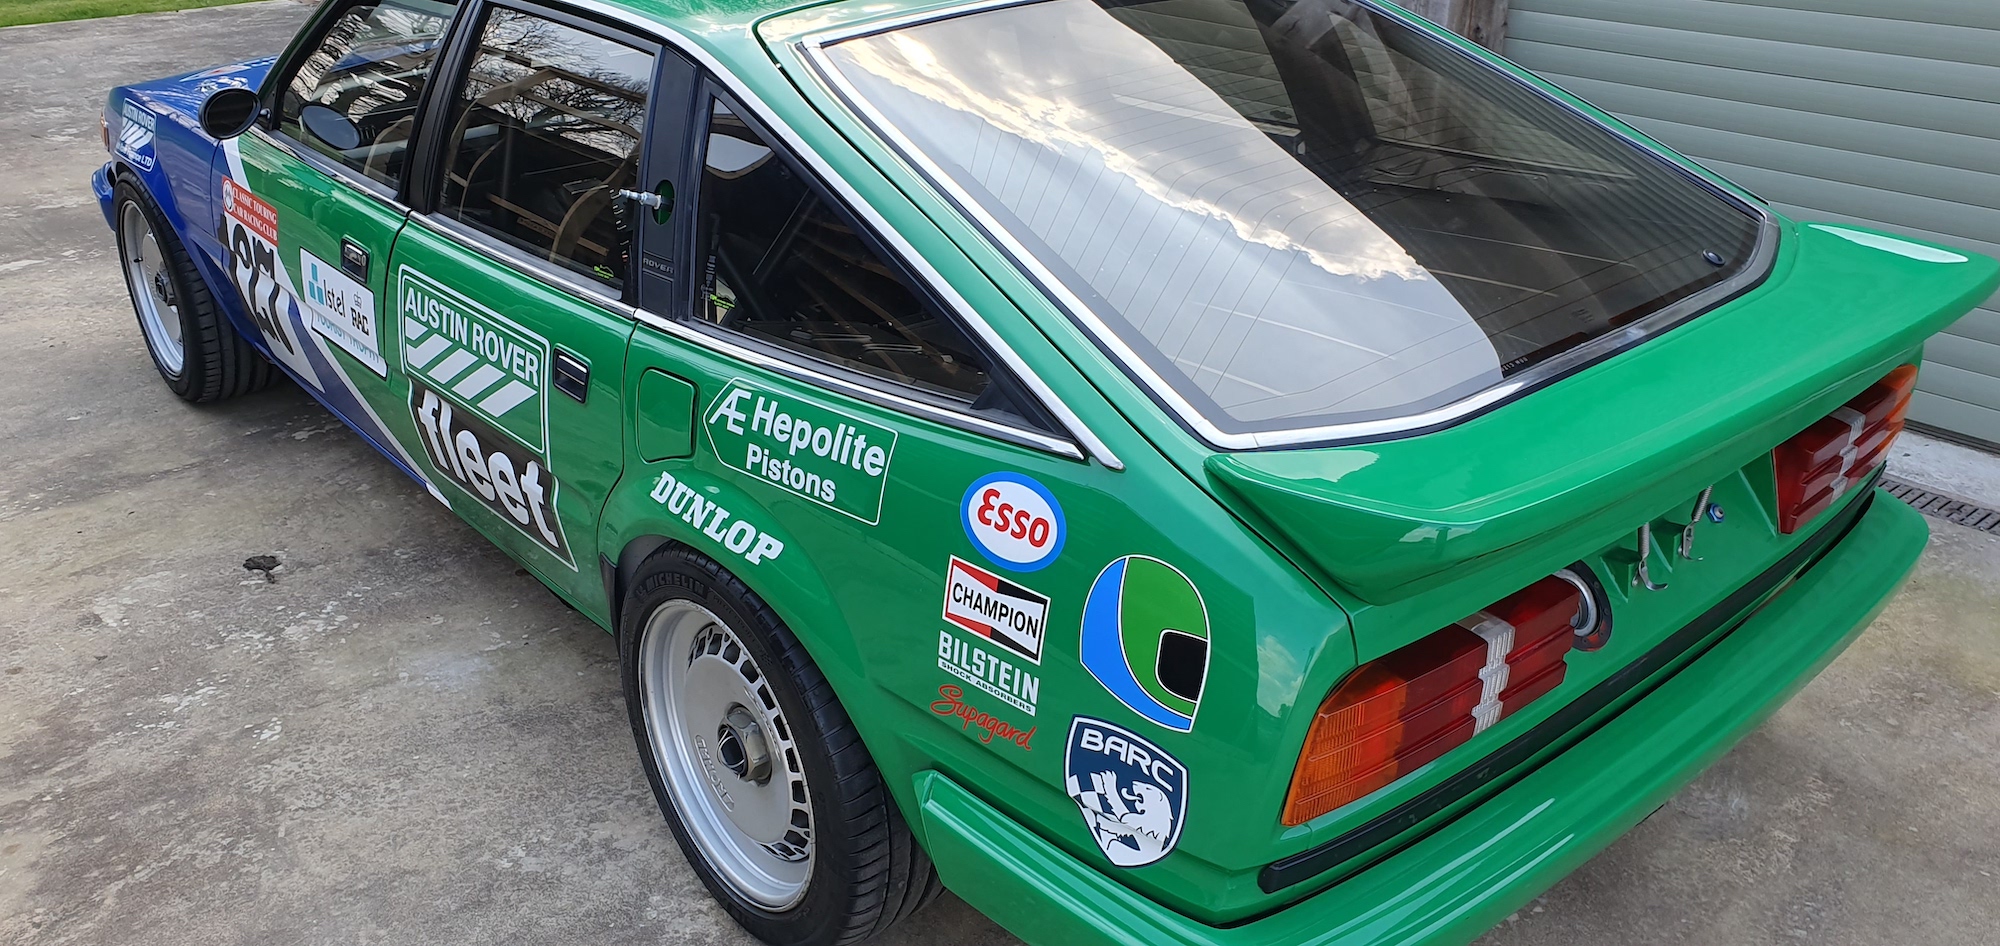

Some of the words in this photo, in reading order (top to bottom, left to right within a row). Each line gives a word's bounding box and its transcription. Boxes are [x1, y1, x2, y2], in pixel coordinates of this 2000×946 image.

[234, 203, 244, 217] CAR
[244, 210, 263, 231] RACING
[263, 223, 278, 241] CLUB
[253, 200, 277, 224] TOURING
[643, 258, 673, 273] ROVER
[350, 307, 369, 336] RAC
[405, 287, 468, 346] AUSTIN
[472, 323, 539, 387] ROVER
[751, 396, 886, 477] Hepolite
[418, 389, 559, 548] fleet
[746, 442, 837, 503] Pistons
[650, 471, 784, 566] DUNLOP
[646, 572, 704, 595] MICHELIN
[952, 582, 1039, 639] CHAMPION
[938, 630, 1040, 705] BILSTEIN
[941, 661, 972, 681] SHOCK
[976, 680, 1032, 713] ABSORBERS
[929, 684, 1037, 750] Supagard
[1081, 728, 1174, 792] BARC
